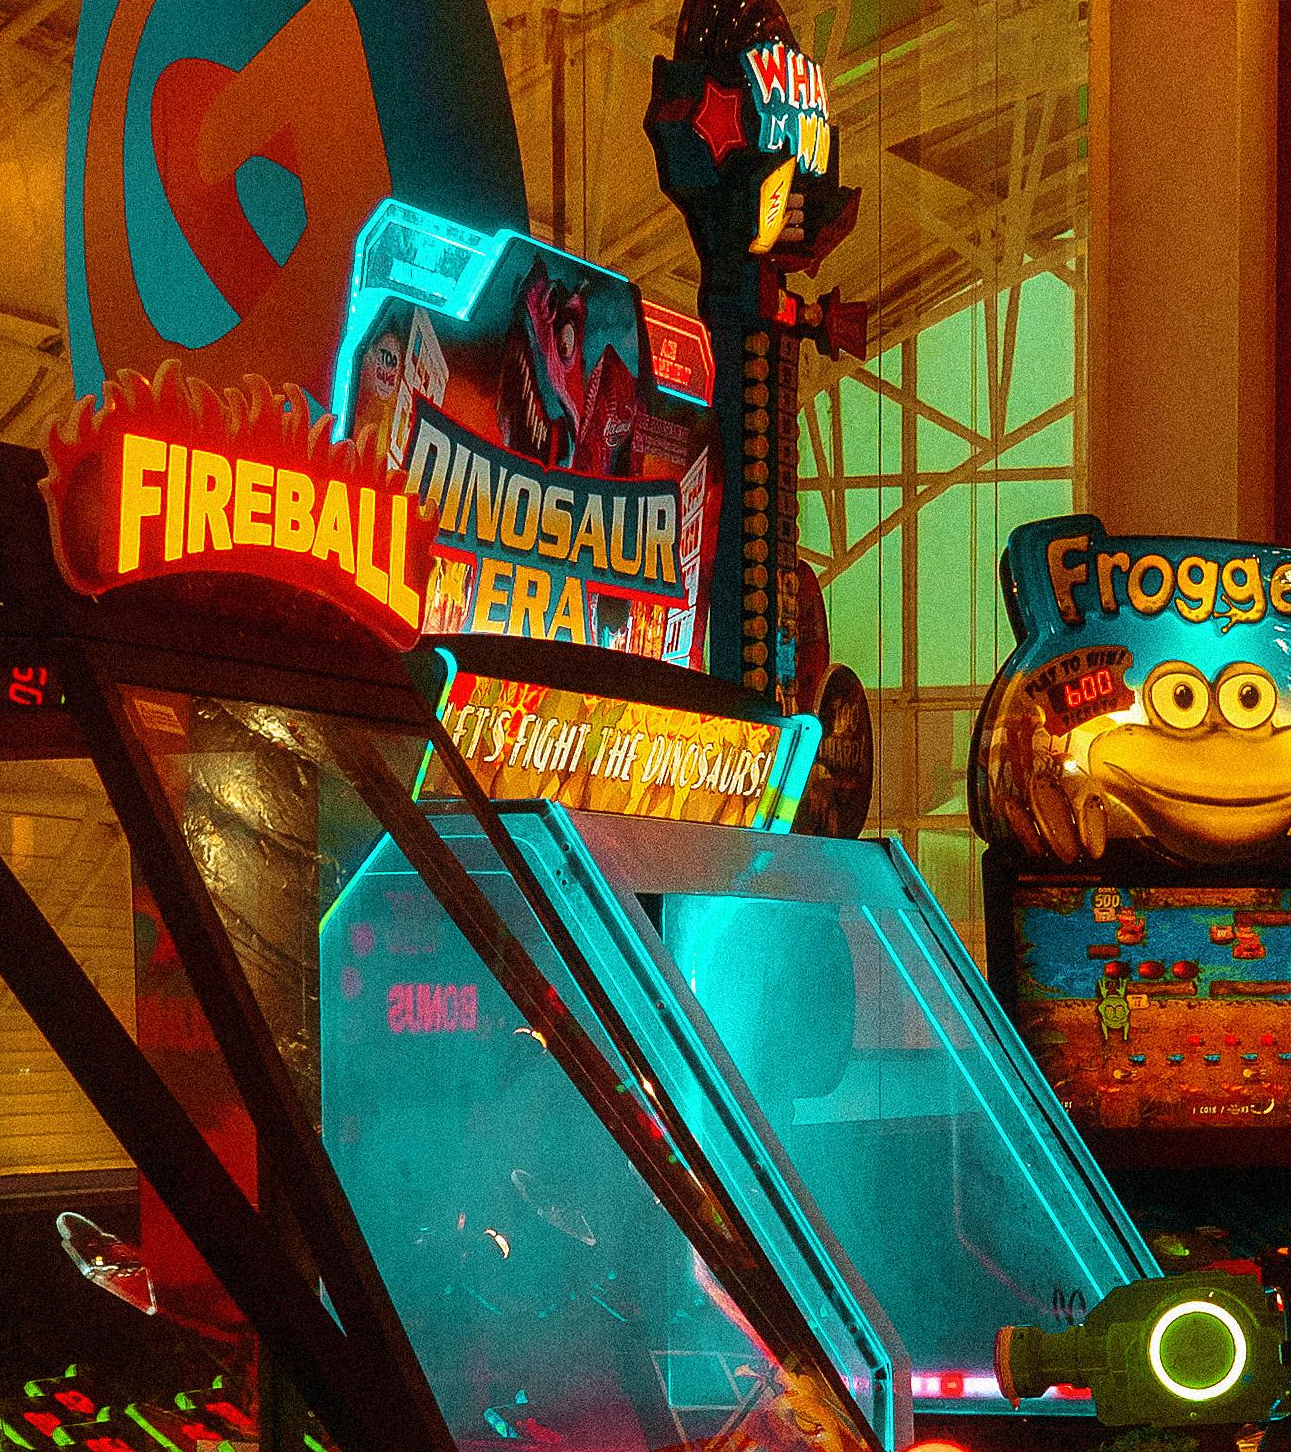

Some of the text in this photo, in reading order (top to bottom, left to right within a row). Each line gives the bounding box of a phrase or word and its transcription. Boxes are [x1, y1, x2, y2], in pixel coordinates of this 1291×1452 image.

[119, 433, 421, 631] FIREBALL
[404, 419, 677, 584] DINOSAUR
[471, 558, 587, 646] ERA
[1065, 669, 1113, 707] 600
[509, 712, 591, 774] FIGHT
[591, 726, 644, 782] THE
[643, 734, 773, 798] DINOSAURS!
